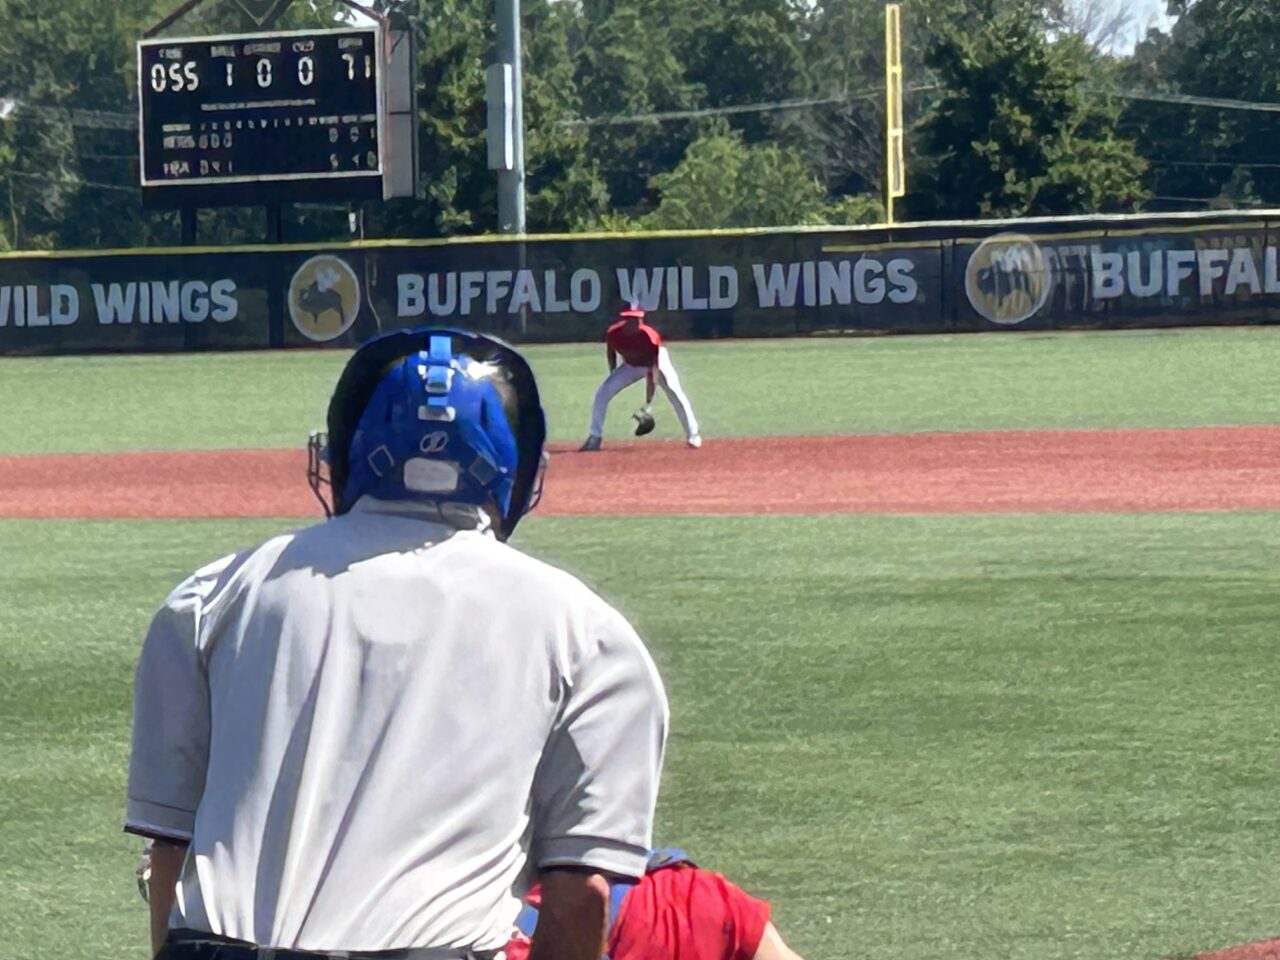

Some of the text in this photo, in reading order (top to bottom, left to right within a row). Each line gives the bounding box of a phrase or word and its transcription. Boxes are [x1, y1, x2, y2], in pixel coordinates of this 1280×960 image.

[226, 63, 233, 86] 1
[257, 58, 272, 88] 0
[298, 56, 313, 86] 0
[91, 279, 238, 325] WINGS
[397, 258, 918, 317] BUFFALO WILD WINGS
